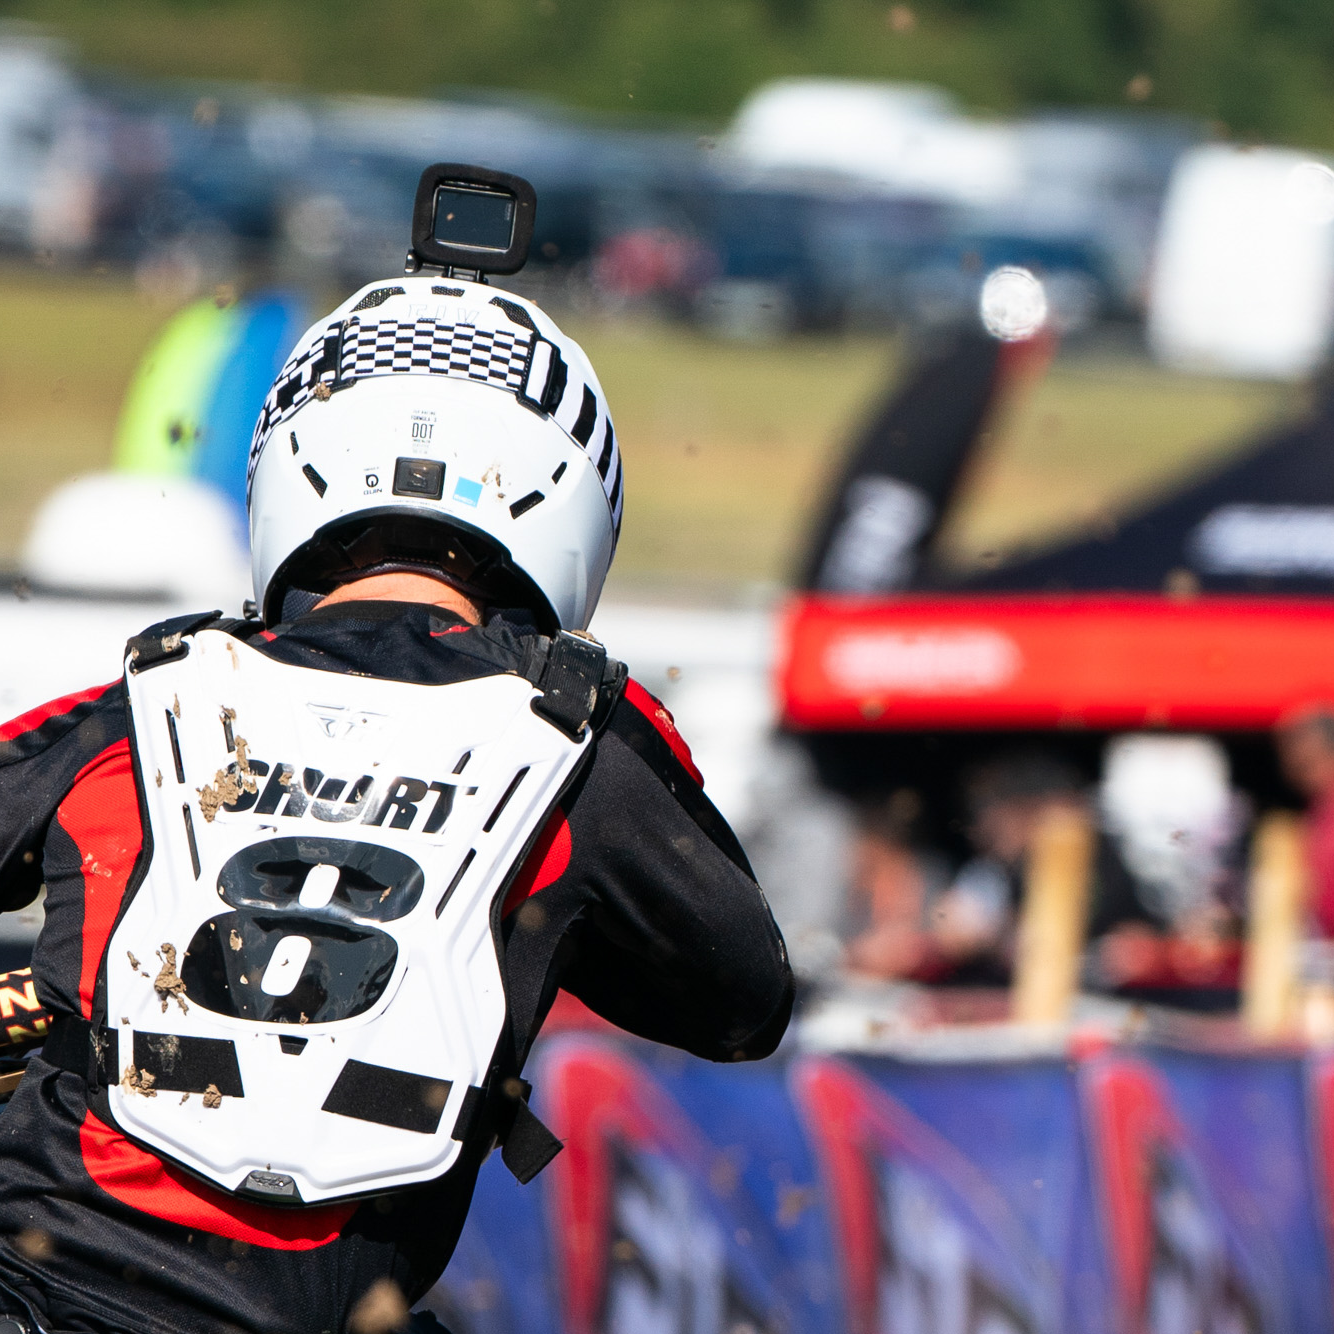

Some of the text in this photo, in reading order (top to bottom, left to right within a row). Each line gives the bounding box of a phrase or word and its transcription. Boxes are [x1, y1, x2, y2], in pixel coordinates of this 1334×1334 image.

[411, 422, 434, 439] DOT
[220, 760, 478, 834] SHORT
[180, 836, 425, 1025] 8
